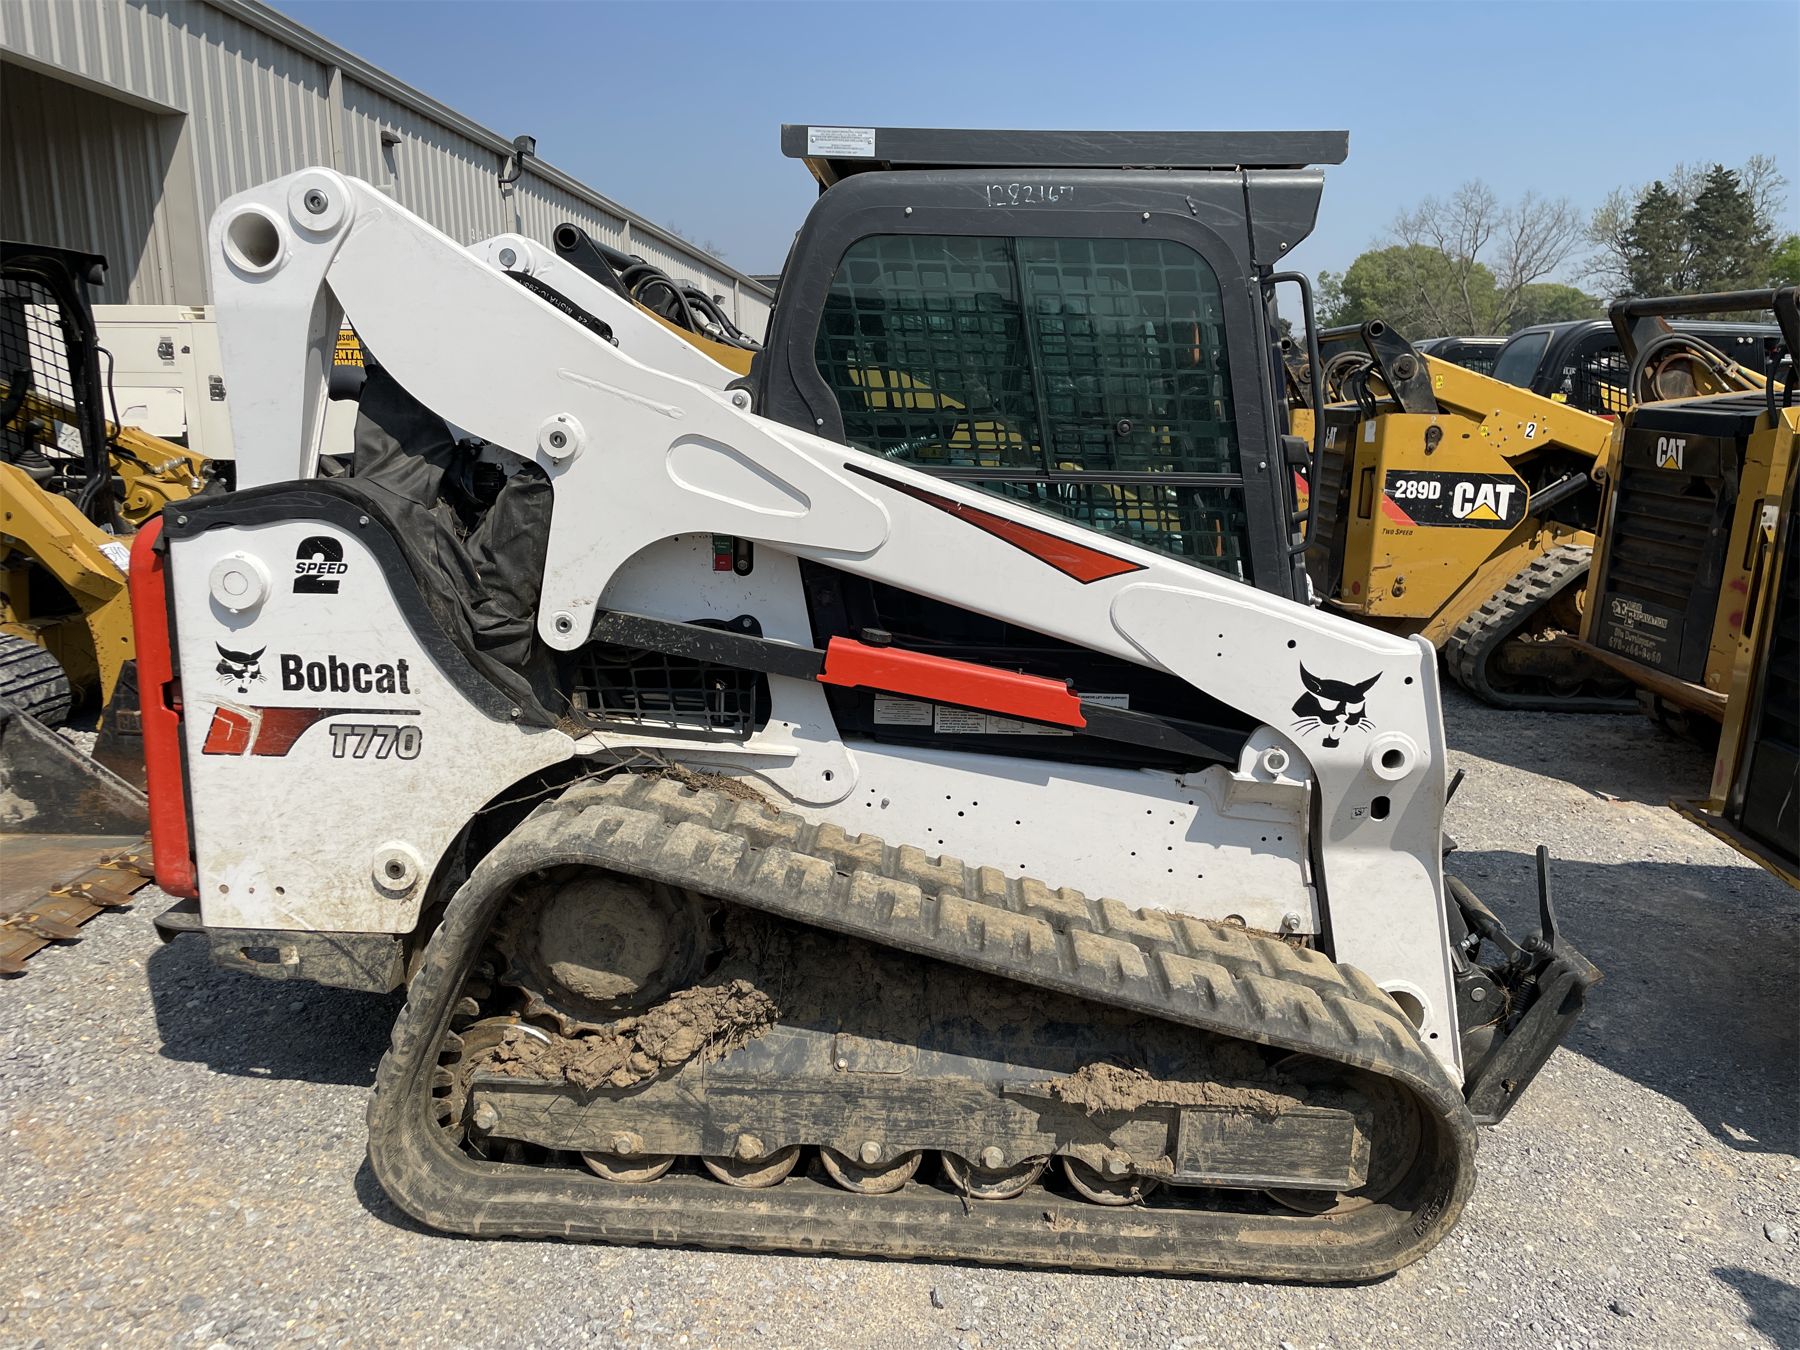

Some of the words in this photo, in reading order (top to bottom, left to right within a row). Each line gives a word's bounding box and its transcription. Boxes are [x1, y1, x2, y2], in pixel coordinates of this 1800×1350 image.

[1526, 424, 1536, 438] 2
[1656, 436, 1687, 470] CAT
[1394, 479, 1442, 500] 289D
[1452, 481, 1516, 521] CAT
[293, 536, 344, 595] 2
[295, 562, 349, 574] SPEED
[280, 653, 411, 695] Bobcat
[329, 723, 423, 761] T770
